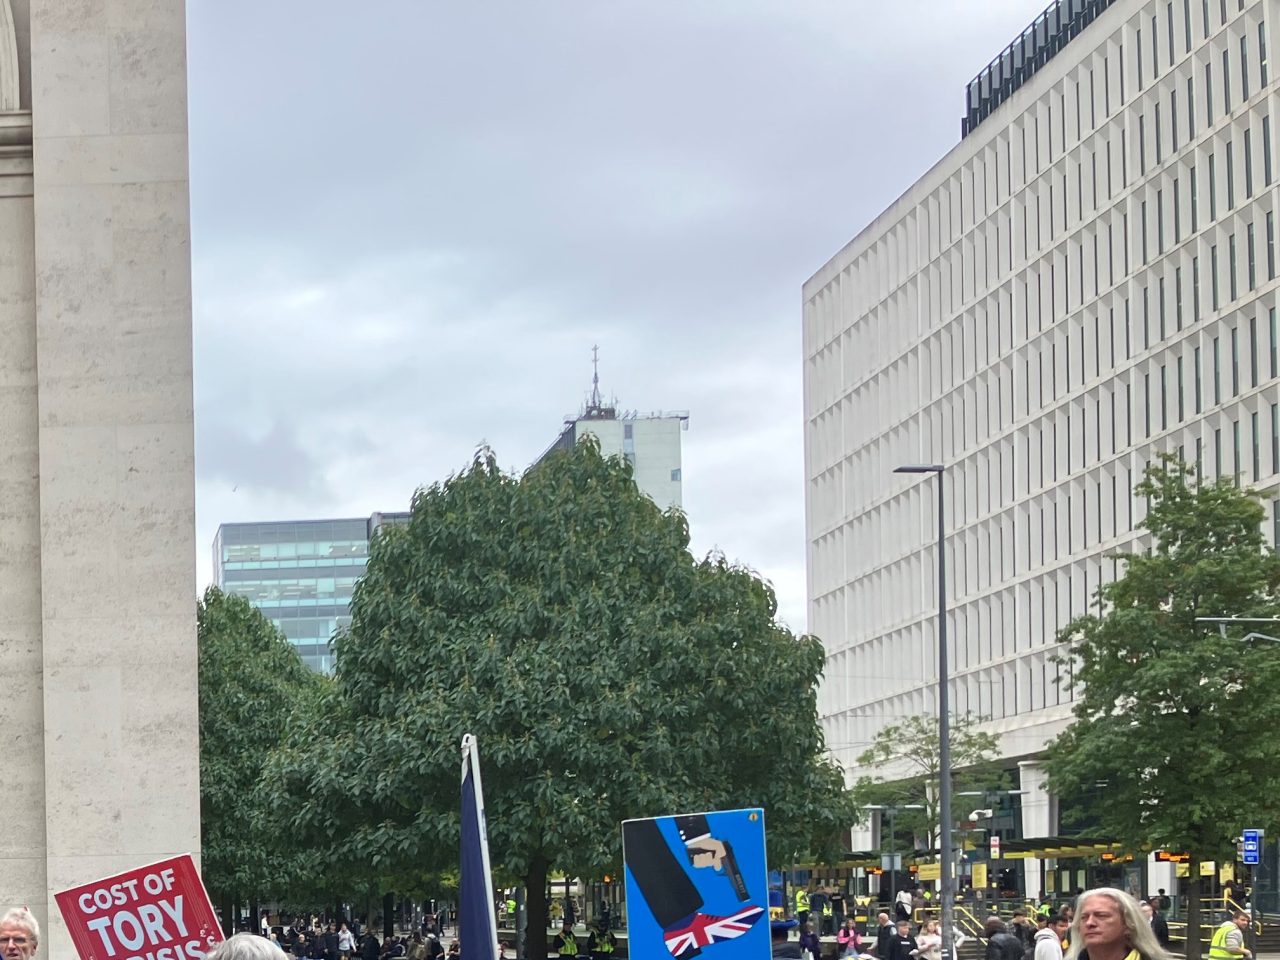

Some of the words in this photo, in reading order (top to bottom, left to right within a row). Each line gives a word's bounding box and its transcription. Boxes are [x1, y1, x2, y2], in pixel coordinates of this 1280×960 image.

[78, 879, 139, 914] COST
[143, 868, 175, 895] OF
[86, 895, 189, 957] TORY
